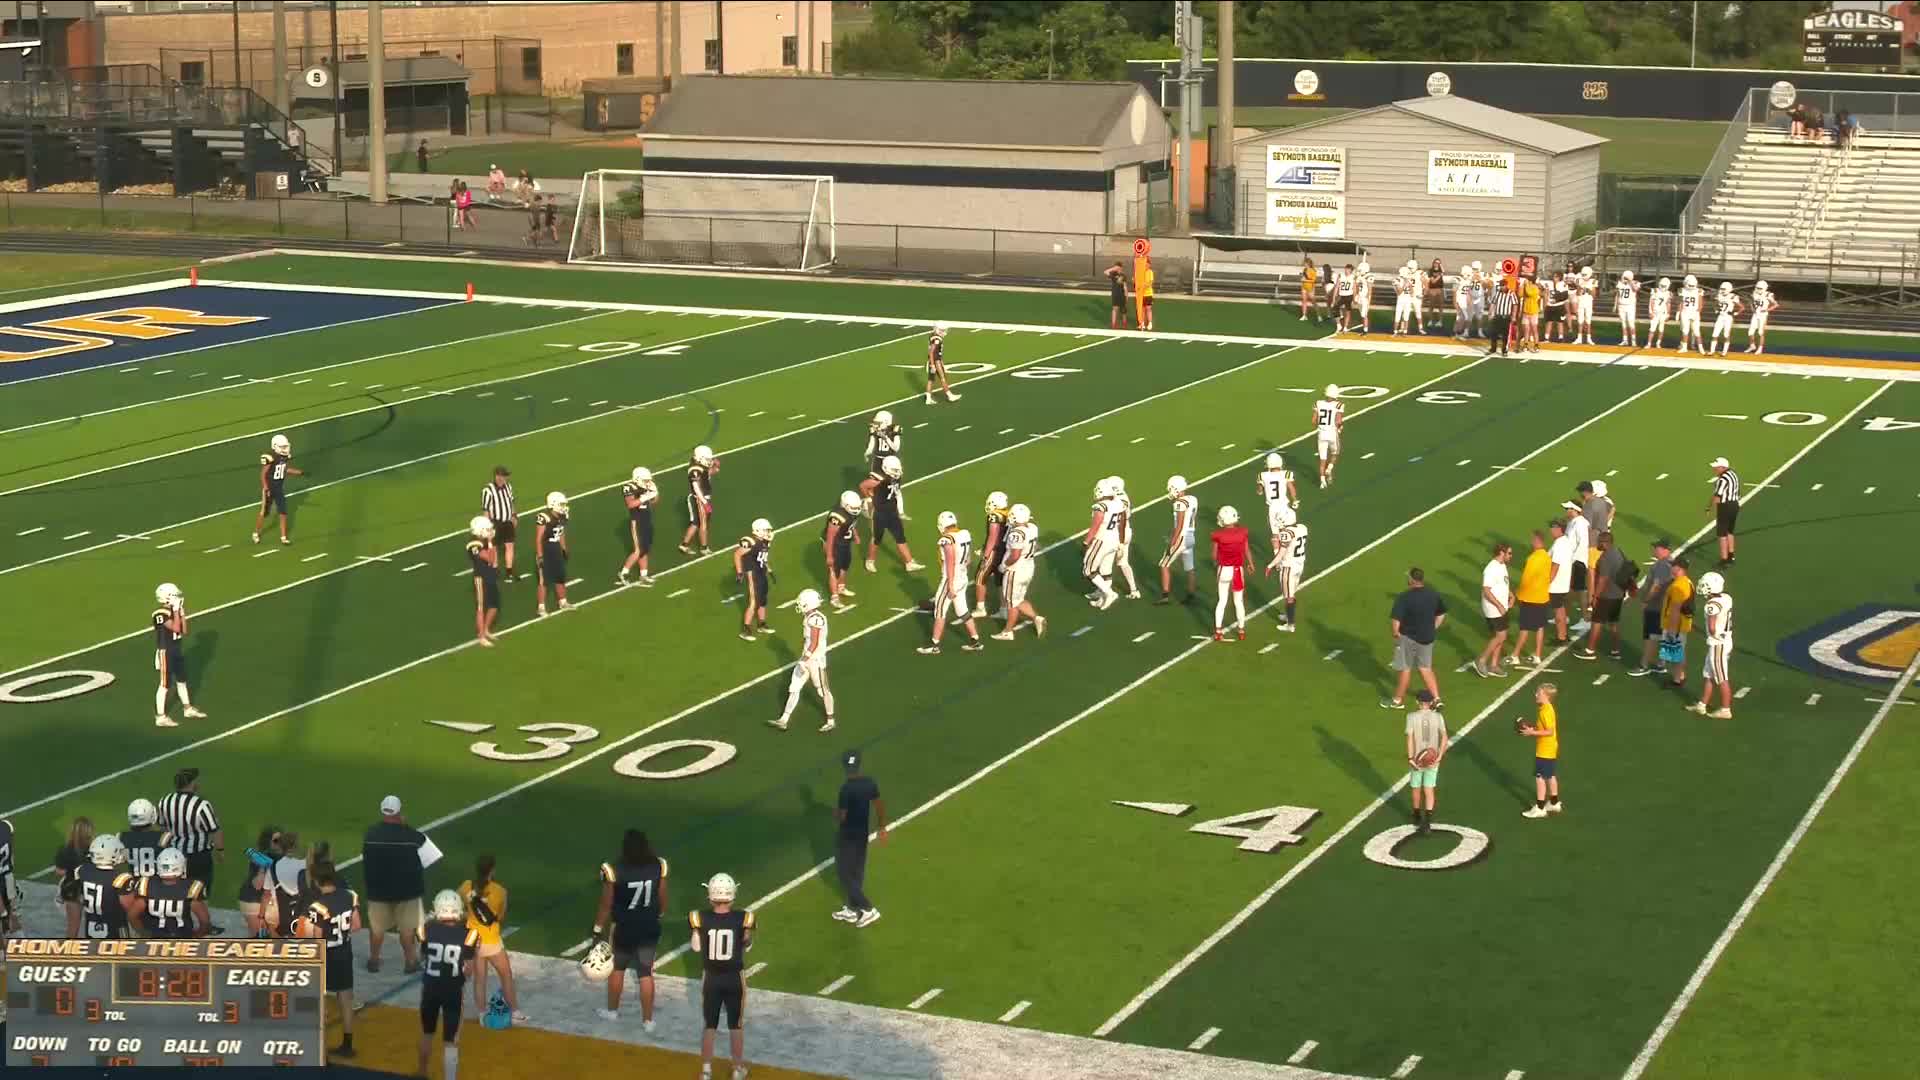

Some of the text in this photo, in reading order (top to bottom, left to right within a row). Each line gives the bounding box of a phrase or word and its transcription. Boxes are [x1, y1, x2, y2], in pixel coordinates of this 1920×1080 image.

[1814, 12, 1893, 29] EAGLES
[313, 73, 321, 82] S
[1273, 152, 1341, 162] SEYMOUR BASEBALL
[1434, 157, 1507, 168] SEYMOUR BASEBALL
[1307, 201, 1338, 209] BASEBALL
[1341, 281, 1351, 291] 20
[1319, 409, 1332, 426] 21
[1269, 481, 1280, 499] 3
[127, 847, 155, 877] 48
[83, 881, 103, 915] 51
[627, 879, 652, 910] 71
[148, 899, 184, 928] 44
[707, 928, 733, 961] 10
[426, 942, 461, 977] 29
